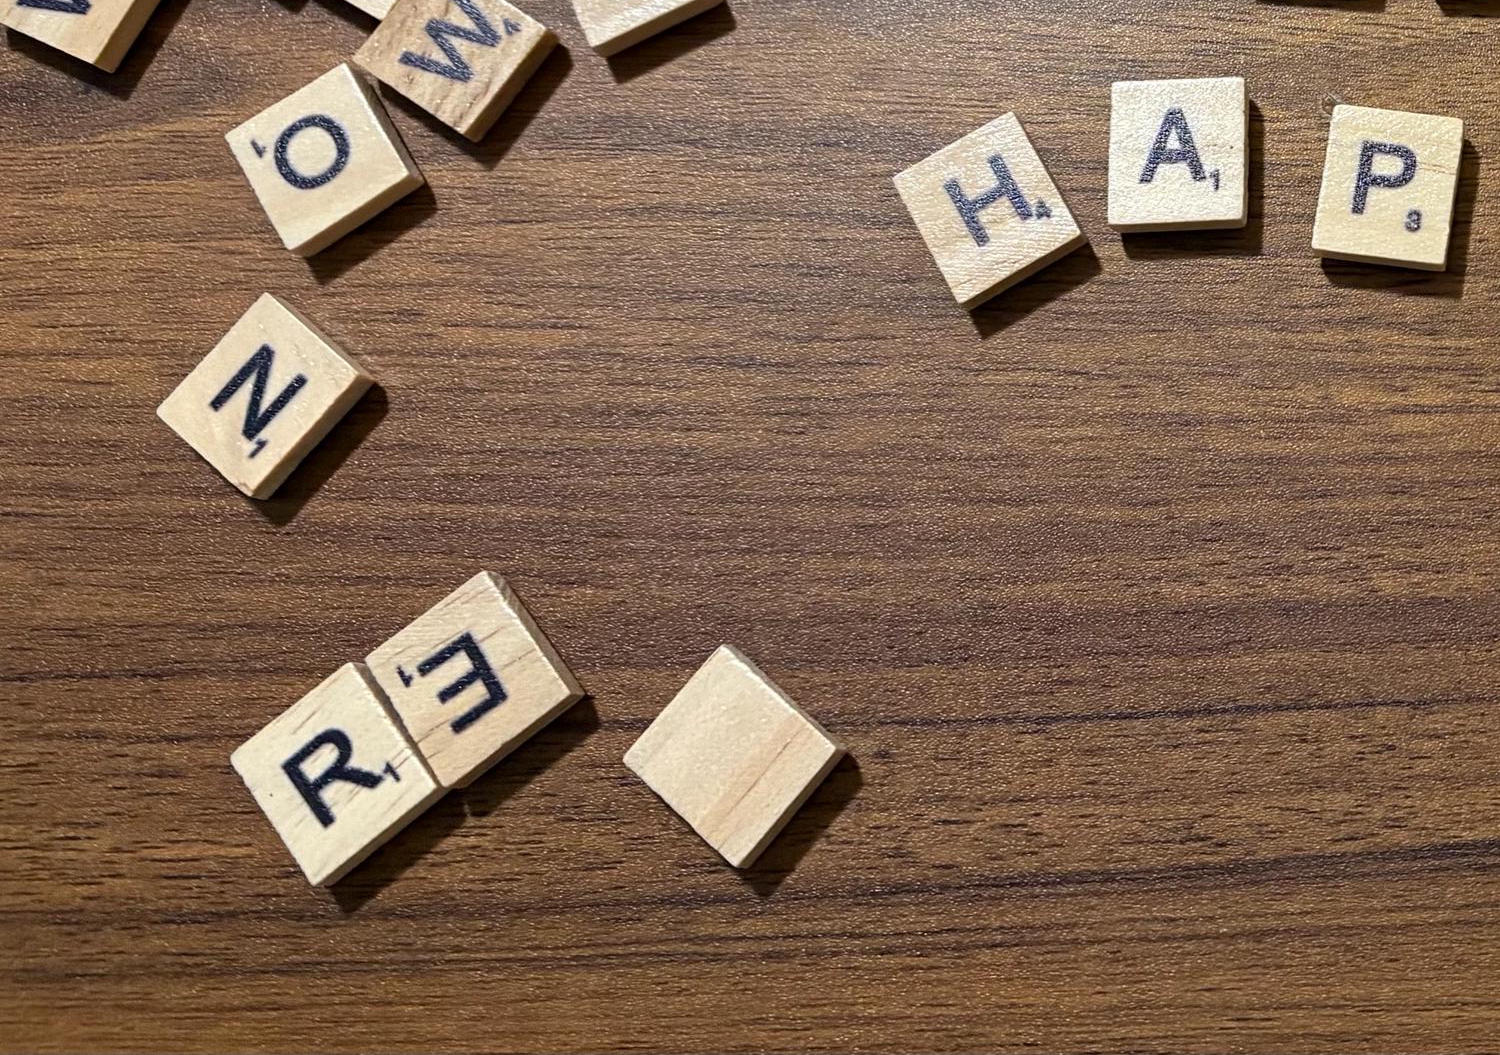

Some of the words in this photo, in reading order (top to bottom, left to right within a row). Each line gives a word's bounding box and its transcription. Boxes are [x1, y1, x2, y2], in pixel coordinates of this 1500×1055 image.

[273, 114, 351, 192] O
[210, 344, 308, 441] N
[248, 437, 269, 458] 1
[416, 631, 509, 734] E
[281, 728, 384, 828] R
[381, 761, 401, 784] 1
